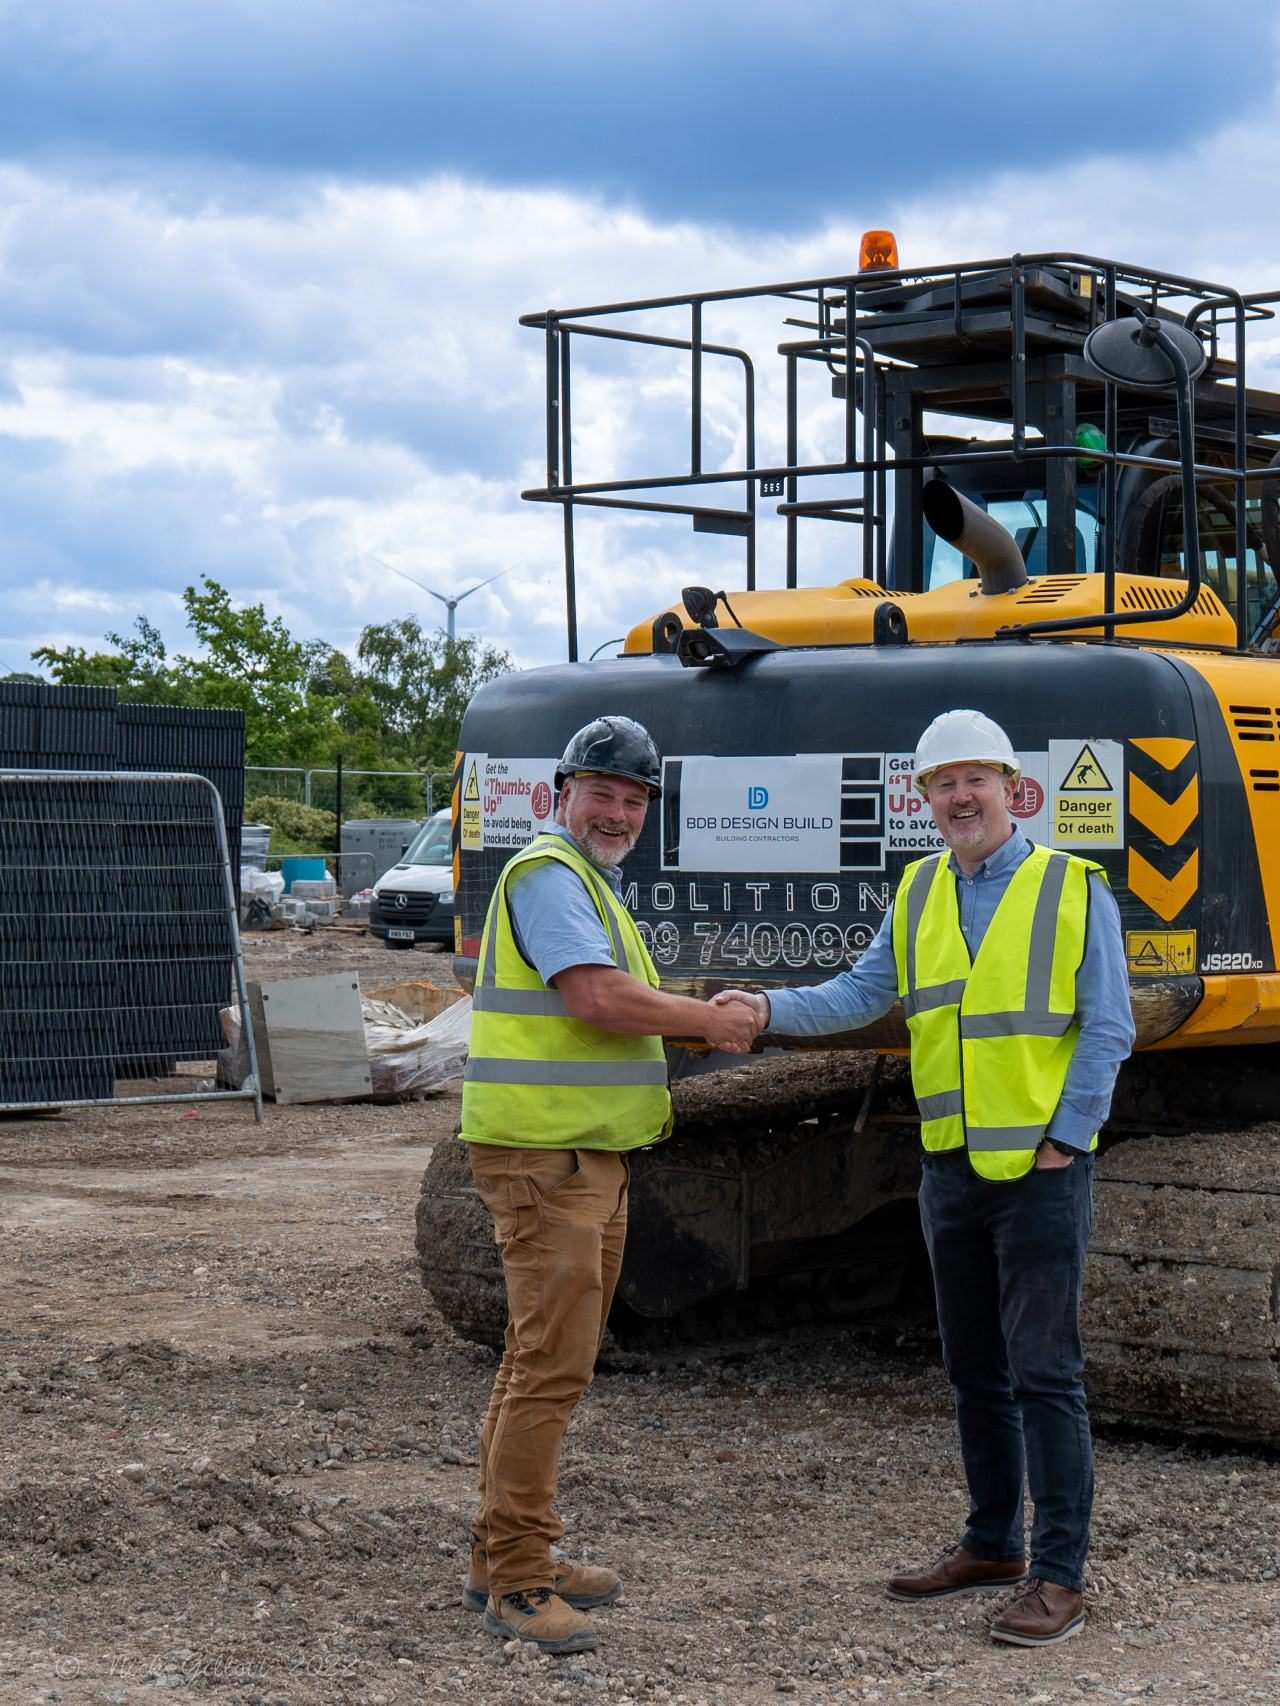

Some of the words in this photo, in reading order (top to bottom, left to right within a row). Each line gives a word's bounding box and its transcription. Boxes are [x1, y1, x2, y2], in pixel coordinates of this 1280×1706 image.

[763, 482, 780, 493] SES
[485, 763, 496, 774] Get
[498, 763, 508, 774] the
[888, 759, 915, 771] Get
[1059, 799, 1112, 815] Danger
[463, 808, 480, 821] Danger
[483, 817, 491, 828] to
[491, 817, 510, 829] avoid
[511, 818, 532, 831] being
[686, 817, 717, 829] BDB
[721, 817, 779, 829] DESIGN
[783, 817, 833, 829] BUILD
[889, 818, 905, 830] to
[909, 819, 937, 830] avo
[1058, 822, 1074, 834] Of
[1078, 823, 1114, 834] death
[469, 829, 480, 839] death
[484, 831, 511, 845] knocked
[889, 834, 945, 847] knocke
[621, 882, 890, 911] MOLITION
[693, 922, 877, 967] 740099
